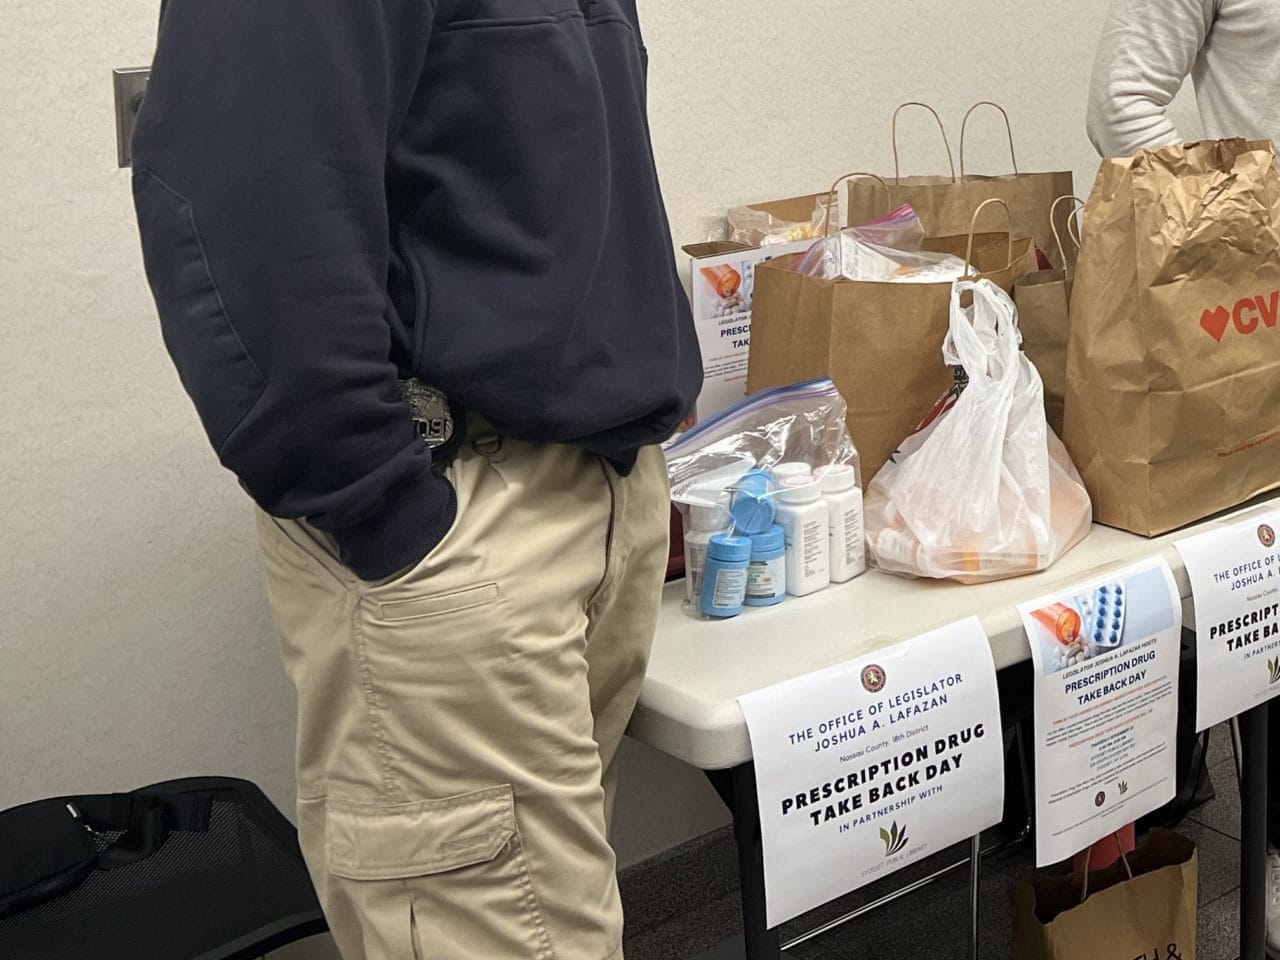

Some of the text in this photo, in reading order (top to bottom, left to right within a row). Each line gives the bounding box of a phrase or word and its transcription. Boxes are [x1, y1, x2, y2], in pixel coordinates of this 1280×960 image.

[1214, 569, 1230, 583] THE
[1233, 559, 1262, 577] OFFICE
[1264, 555, 1275, 566] OF
[1231, 572, 1264, 591] JOSHUA
[1226, 629, 1260, 652] TAKE
[1244, 651, 1251, 660] IN
[1062, 663, 1094, 679] LEGISLATOR
[1065, 650, 1156, 694] PRESCRIPTION DRUG
[1077, 669, 1147, 705] TAKE BACK DAY
[789, 673, 963, 745] THE OFFICE OF LEGISLATOR
[814, 694, 949, 752] JOSHUA A. LAFAZAN
[840, 750, 865, 763] Nassau
[905, 725, 929, 738] District
[781, 723, 985, 815] PRESCRIPTION DRUG
[810, 753, 963, 826] TAKE BACK DAY
[839, 785, 943, 833] IN PARTNERSHIP WITH
